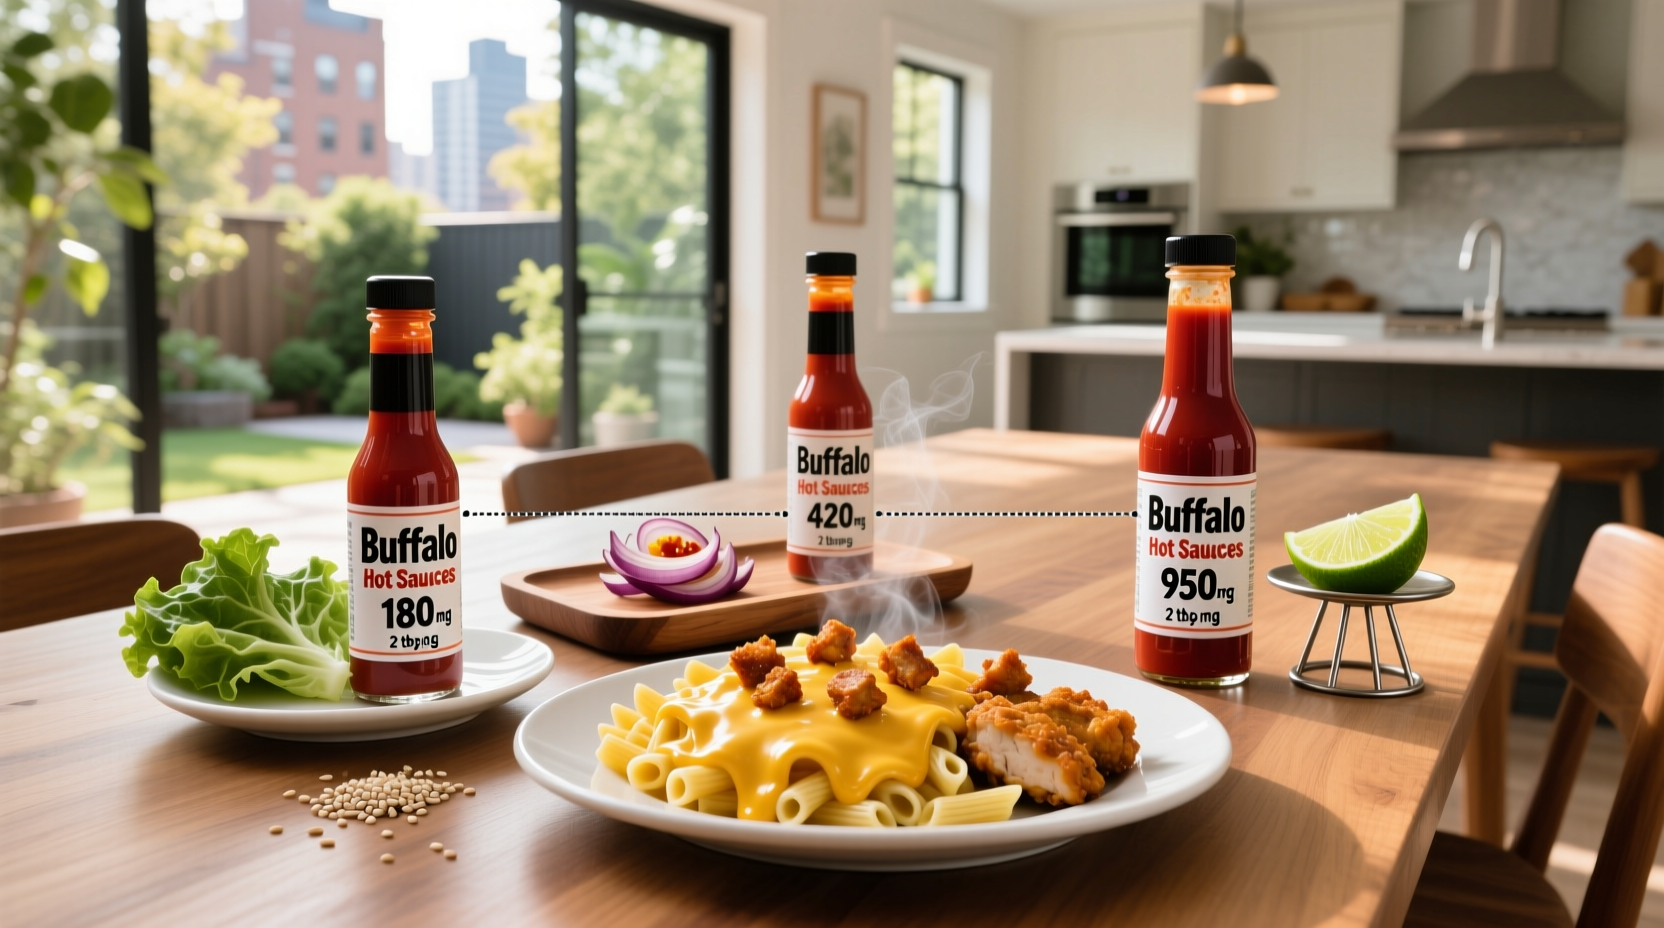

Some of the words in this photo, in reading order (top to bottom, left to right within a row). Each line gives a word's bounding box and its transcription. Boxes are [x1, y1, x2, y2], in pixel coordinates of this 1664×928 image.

[798, 446, 869, 475] Buffalo
[798, 479, 818, 495] Hot
[807, 503, 853, 528] 420
[1149, 495, 1245, 533] Buffalo
[362, 524, 456, 564] Buffalo
[1150, 537, 1174, 558] Hot
[364, 569, 393, 589] Hot
[1161, 568, 1217, 600] 950
[382, 596, 434, 628] 180
[1166, 608, 1173, 621] 2
[390, 636, 397, 648] 2
